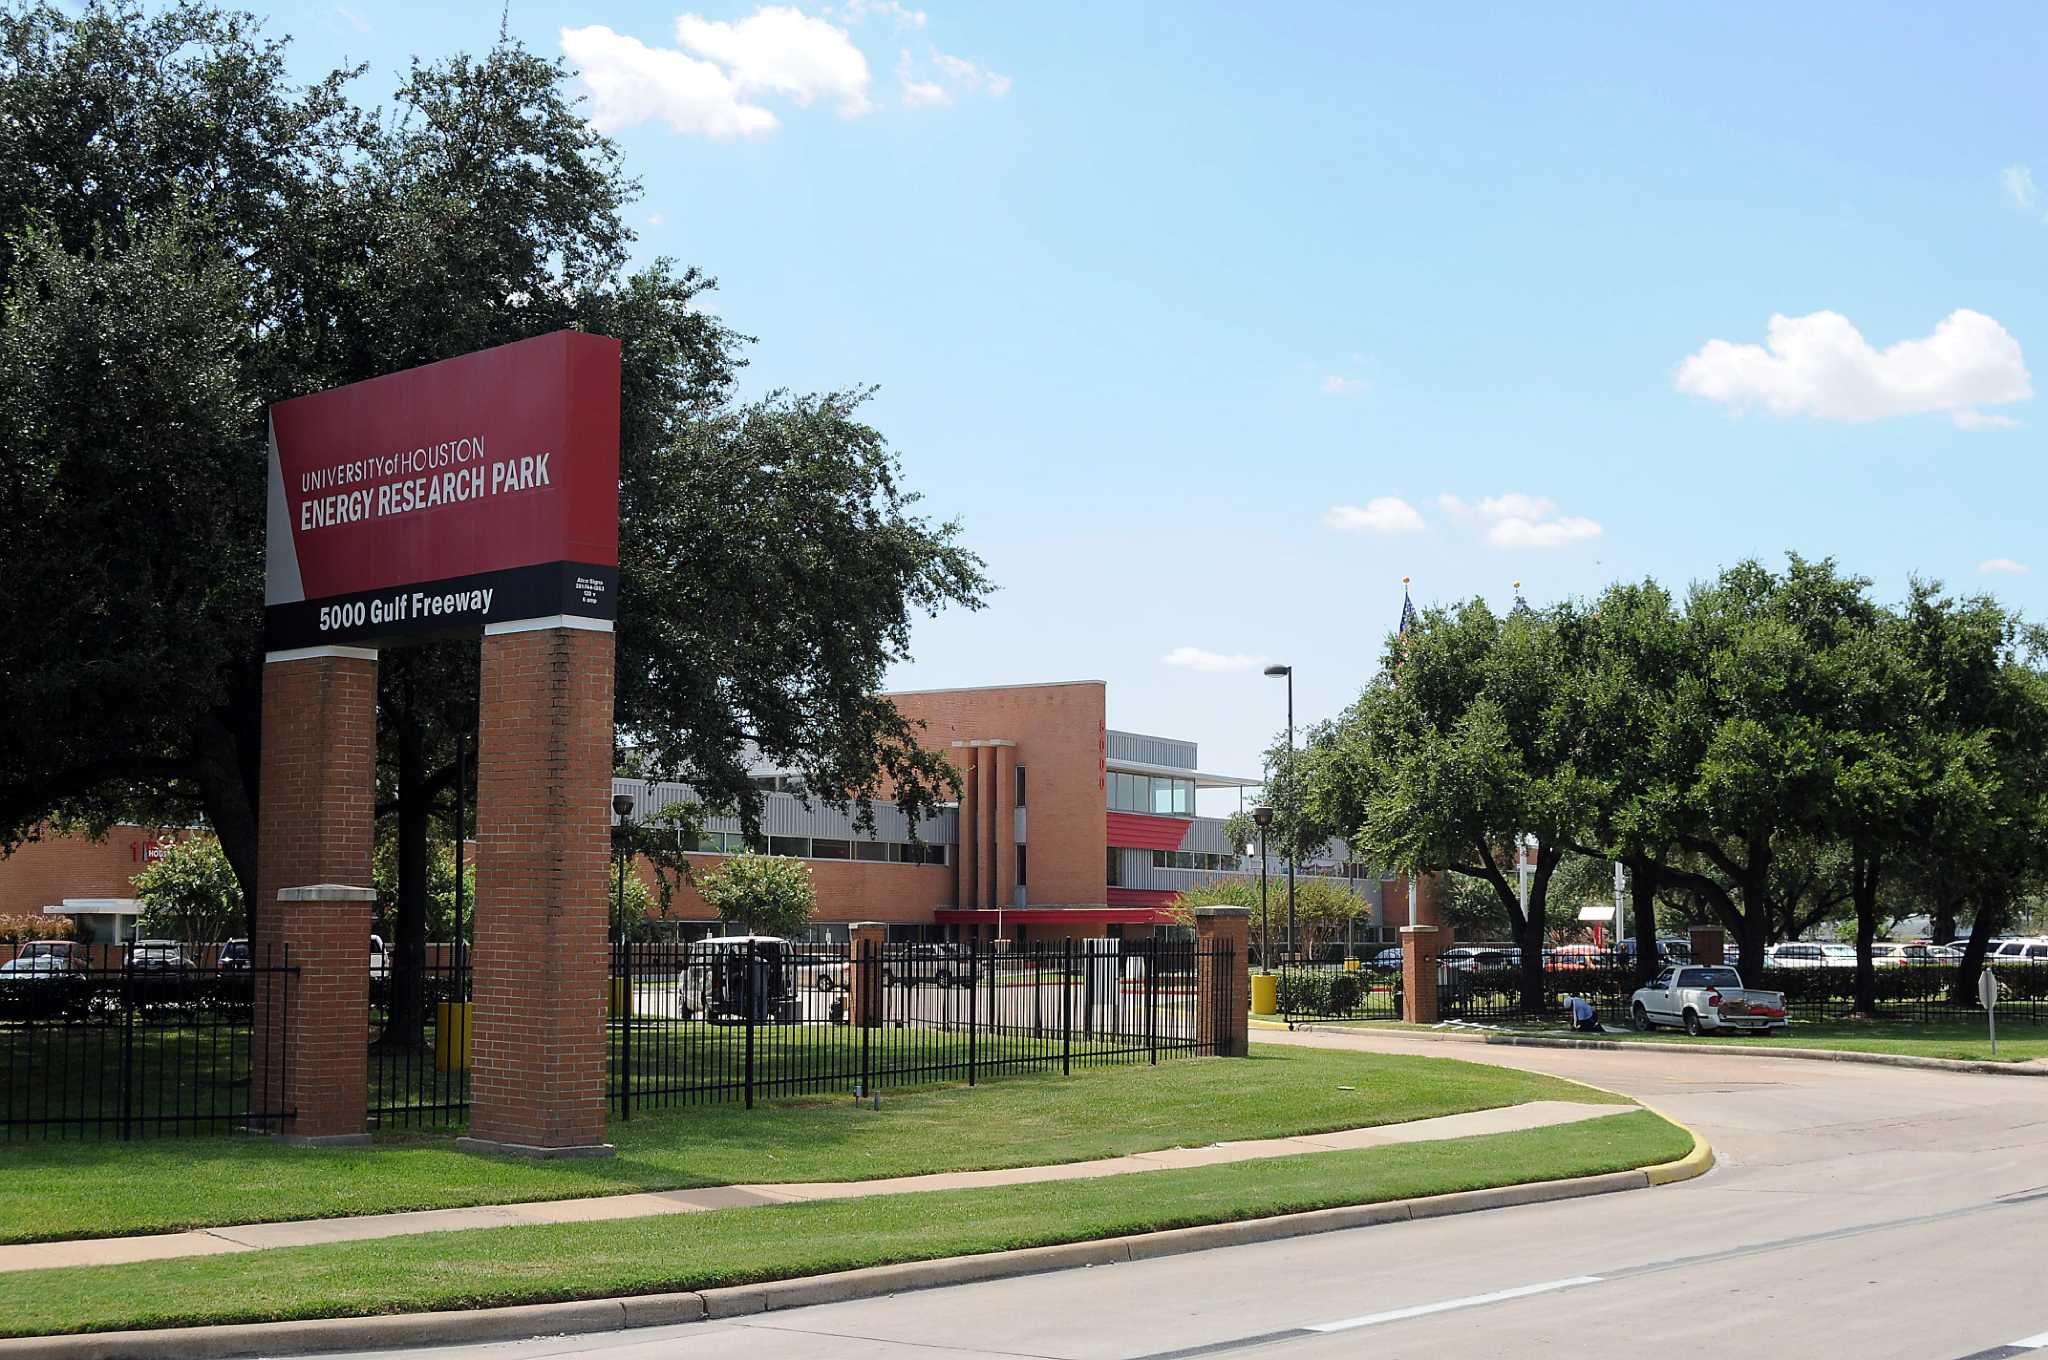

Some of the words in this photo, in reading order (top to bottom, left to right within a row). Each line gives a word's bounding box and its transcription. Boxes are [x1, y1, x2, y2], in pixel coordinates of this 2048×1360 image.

[301, 488, 374, 531] ENERGY
[378, 465, 485, 516] RESEARCH
[492, 452, 550, 495] PARK
[302, 456, 384, 492] UNIVERSITY
[385, 453, 398, 475] of
[401, 435, 485, 475] HOUSTON
[319, 602, 366, 631] 5000
[370, 594, 408, 624] Gulf
[412, 588, 494, 618] Freeway
